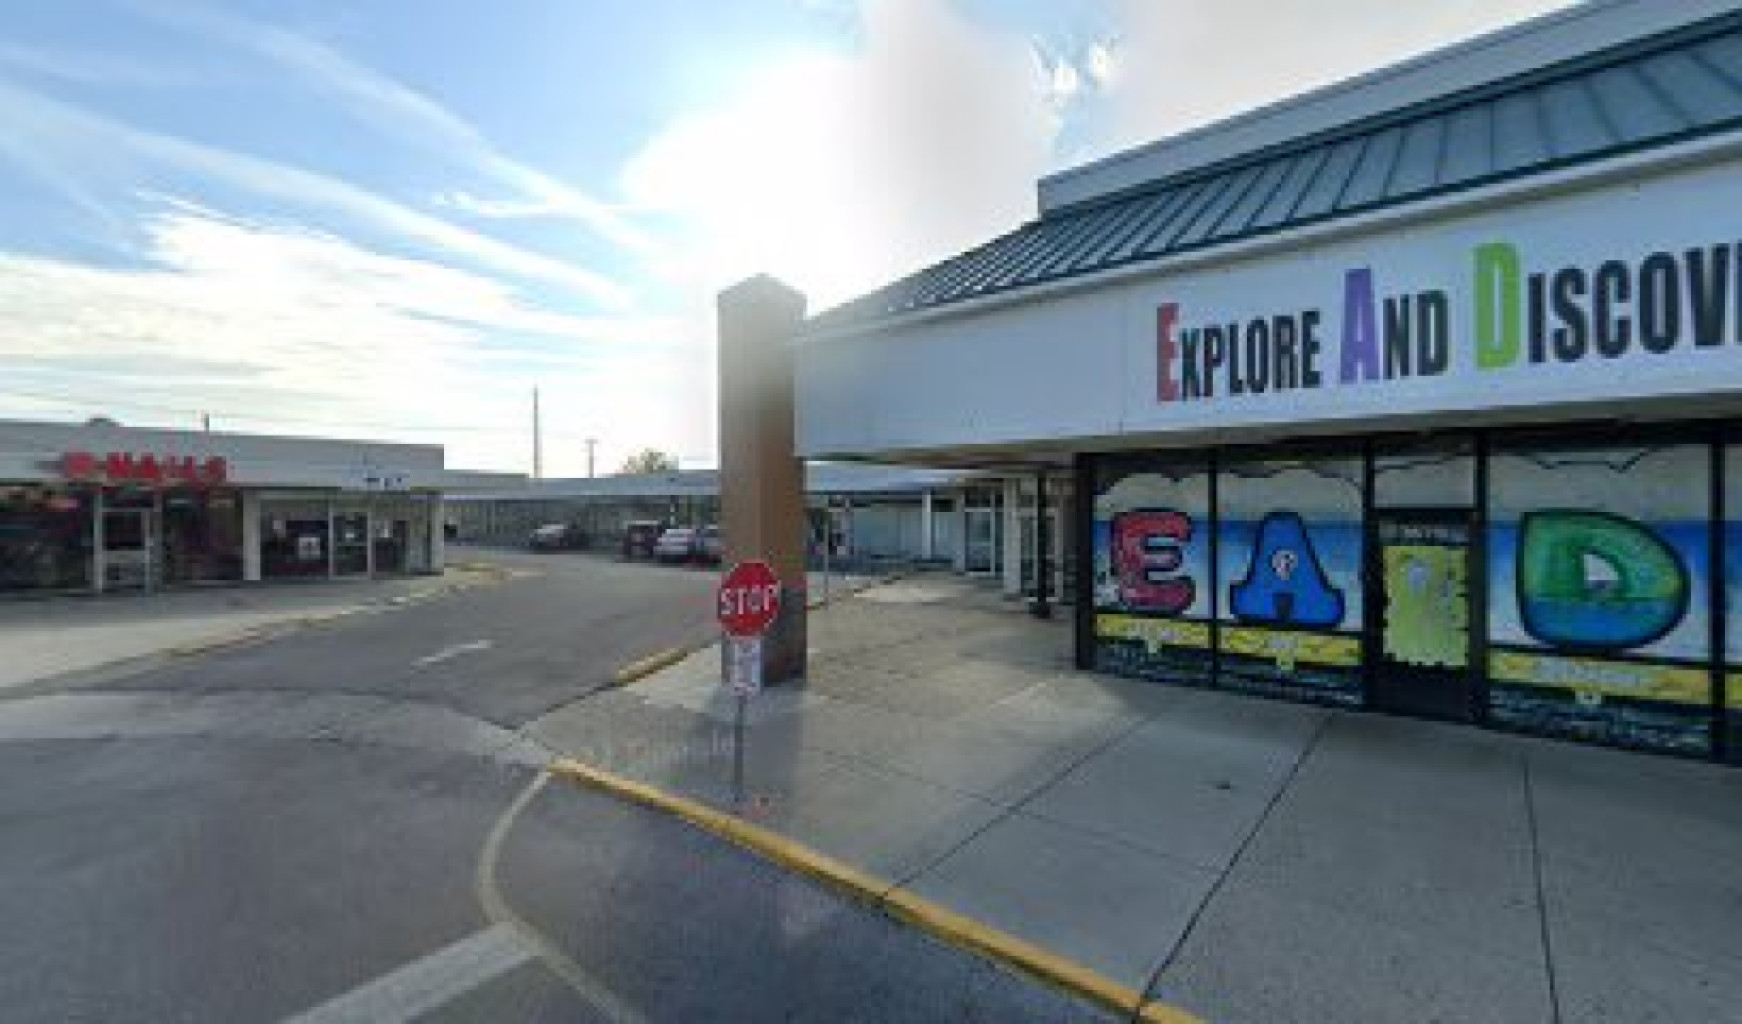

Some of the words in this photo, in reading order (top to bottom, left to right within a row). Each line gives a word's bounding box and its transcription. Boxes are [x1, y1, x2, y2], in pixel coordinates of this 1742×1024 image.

[1156, 303, 1323, 402] EXPLORE
[1341, 266, 1449, 384] AND
[1473, 239, 1742, 370] DISCOV
[719, 582, 781, 615] STOP
